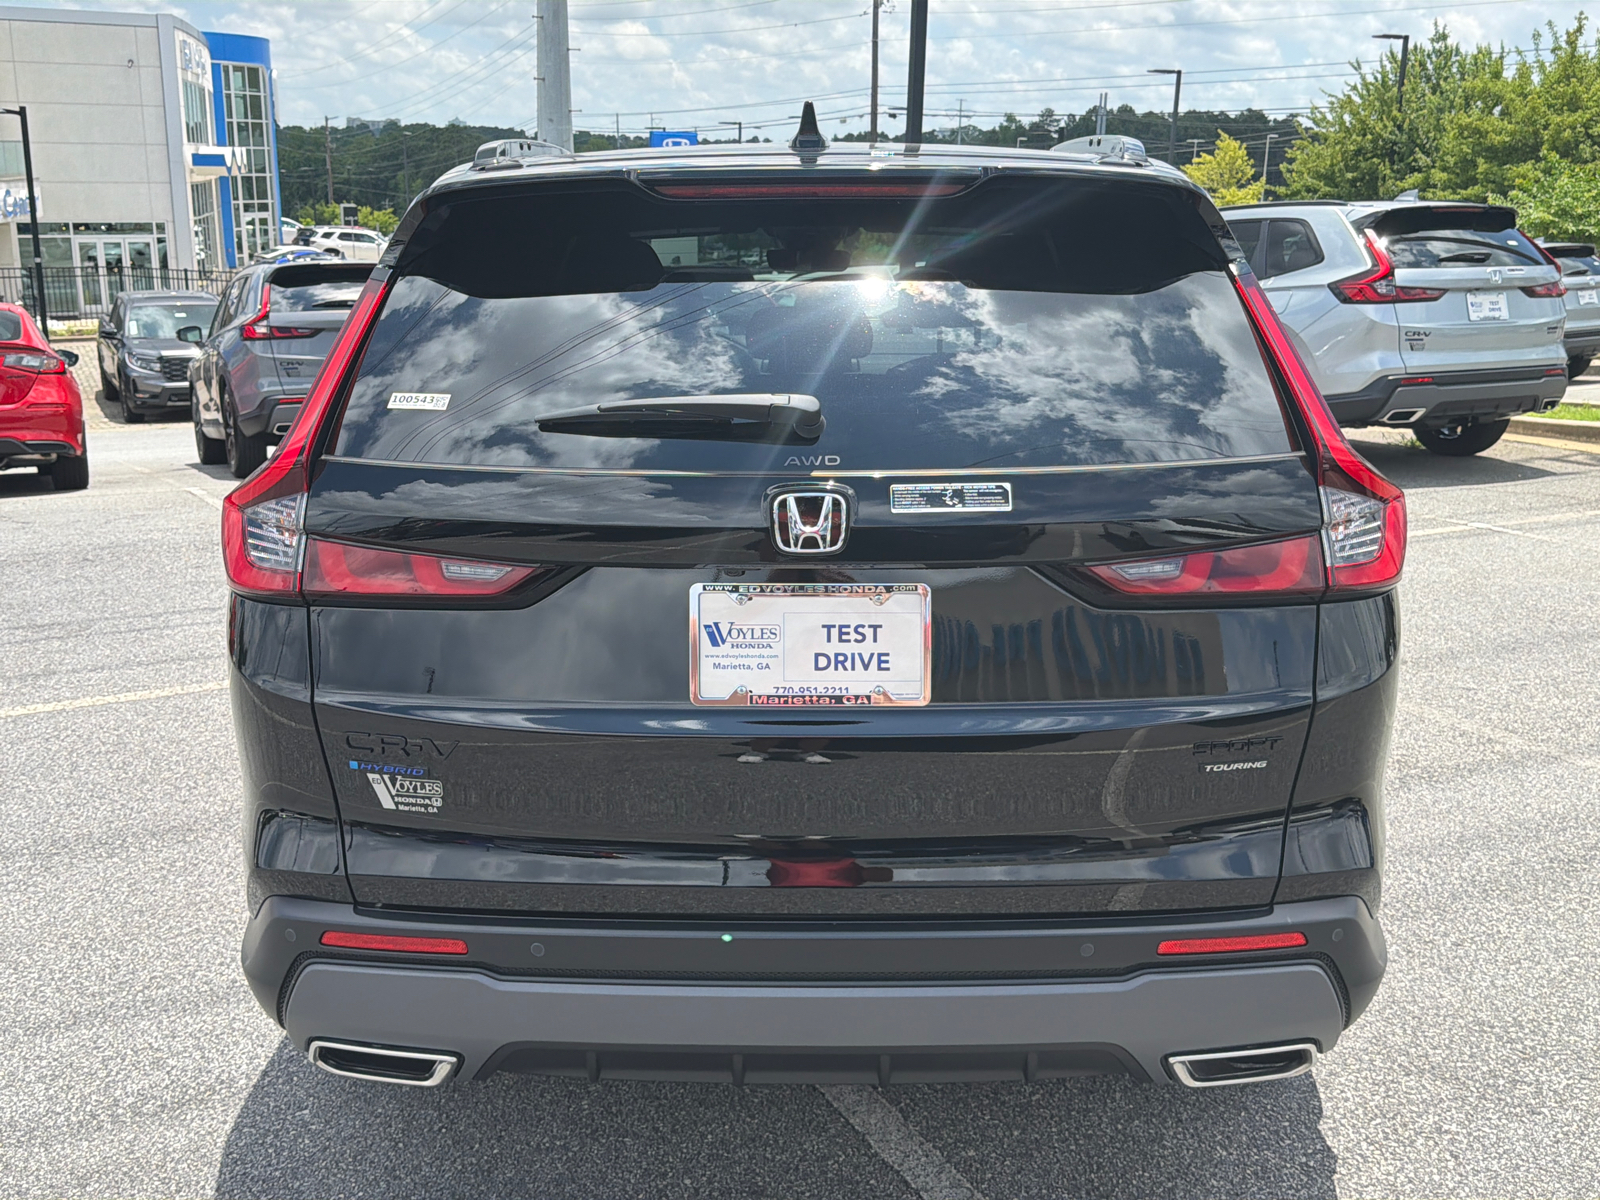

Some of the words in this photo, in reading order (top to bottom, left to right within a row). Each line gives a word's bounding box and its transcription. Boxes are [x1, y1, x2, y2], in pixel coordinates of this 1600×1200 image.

[391, 395, 435, 404] 100543
[783, 455, 841, 467] AWD
[712, 622, 778, 645] VOYLES
[821, 624, 883, 643] TEST
[712, 662, 754, 671] Marietta,
[756, 662, 771, 670] GA
[814, 652, 891, 671] DRIVE
[773, 686, 850, 694] 770-951-2211
[752, 695, 836, 705] Marietta,
[842, 695, 869, 704] GA
[343, 730, 461, 760] CR-V
[1192, 735, 1285, 756] SPORT
[360, 762, 425, 776] HYBRID
[1204, 760, 1268, 772] TOURING
[371, 777, 382, 785] ED
[382, 774, 442, 796] VOYLES
[394, 796, 431, 805] HONDA
[398, 804, 427, 813] Marietta,
